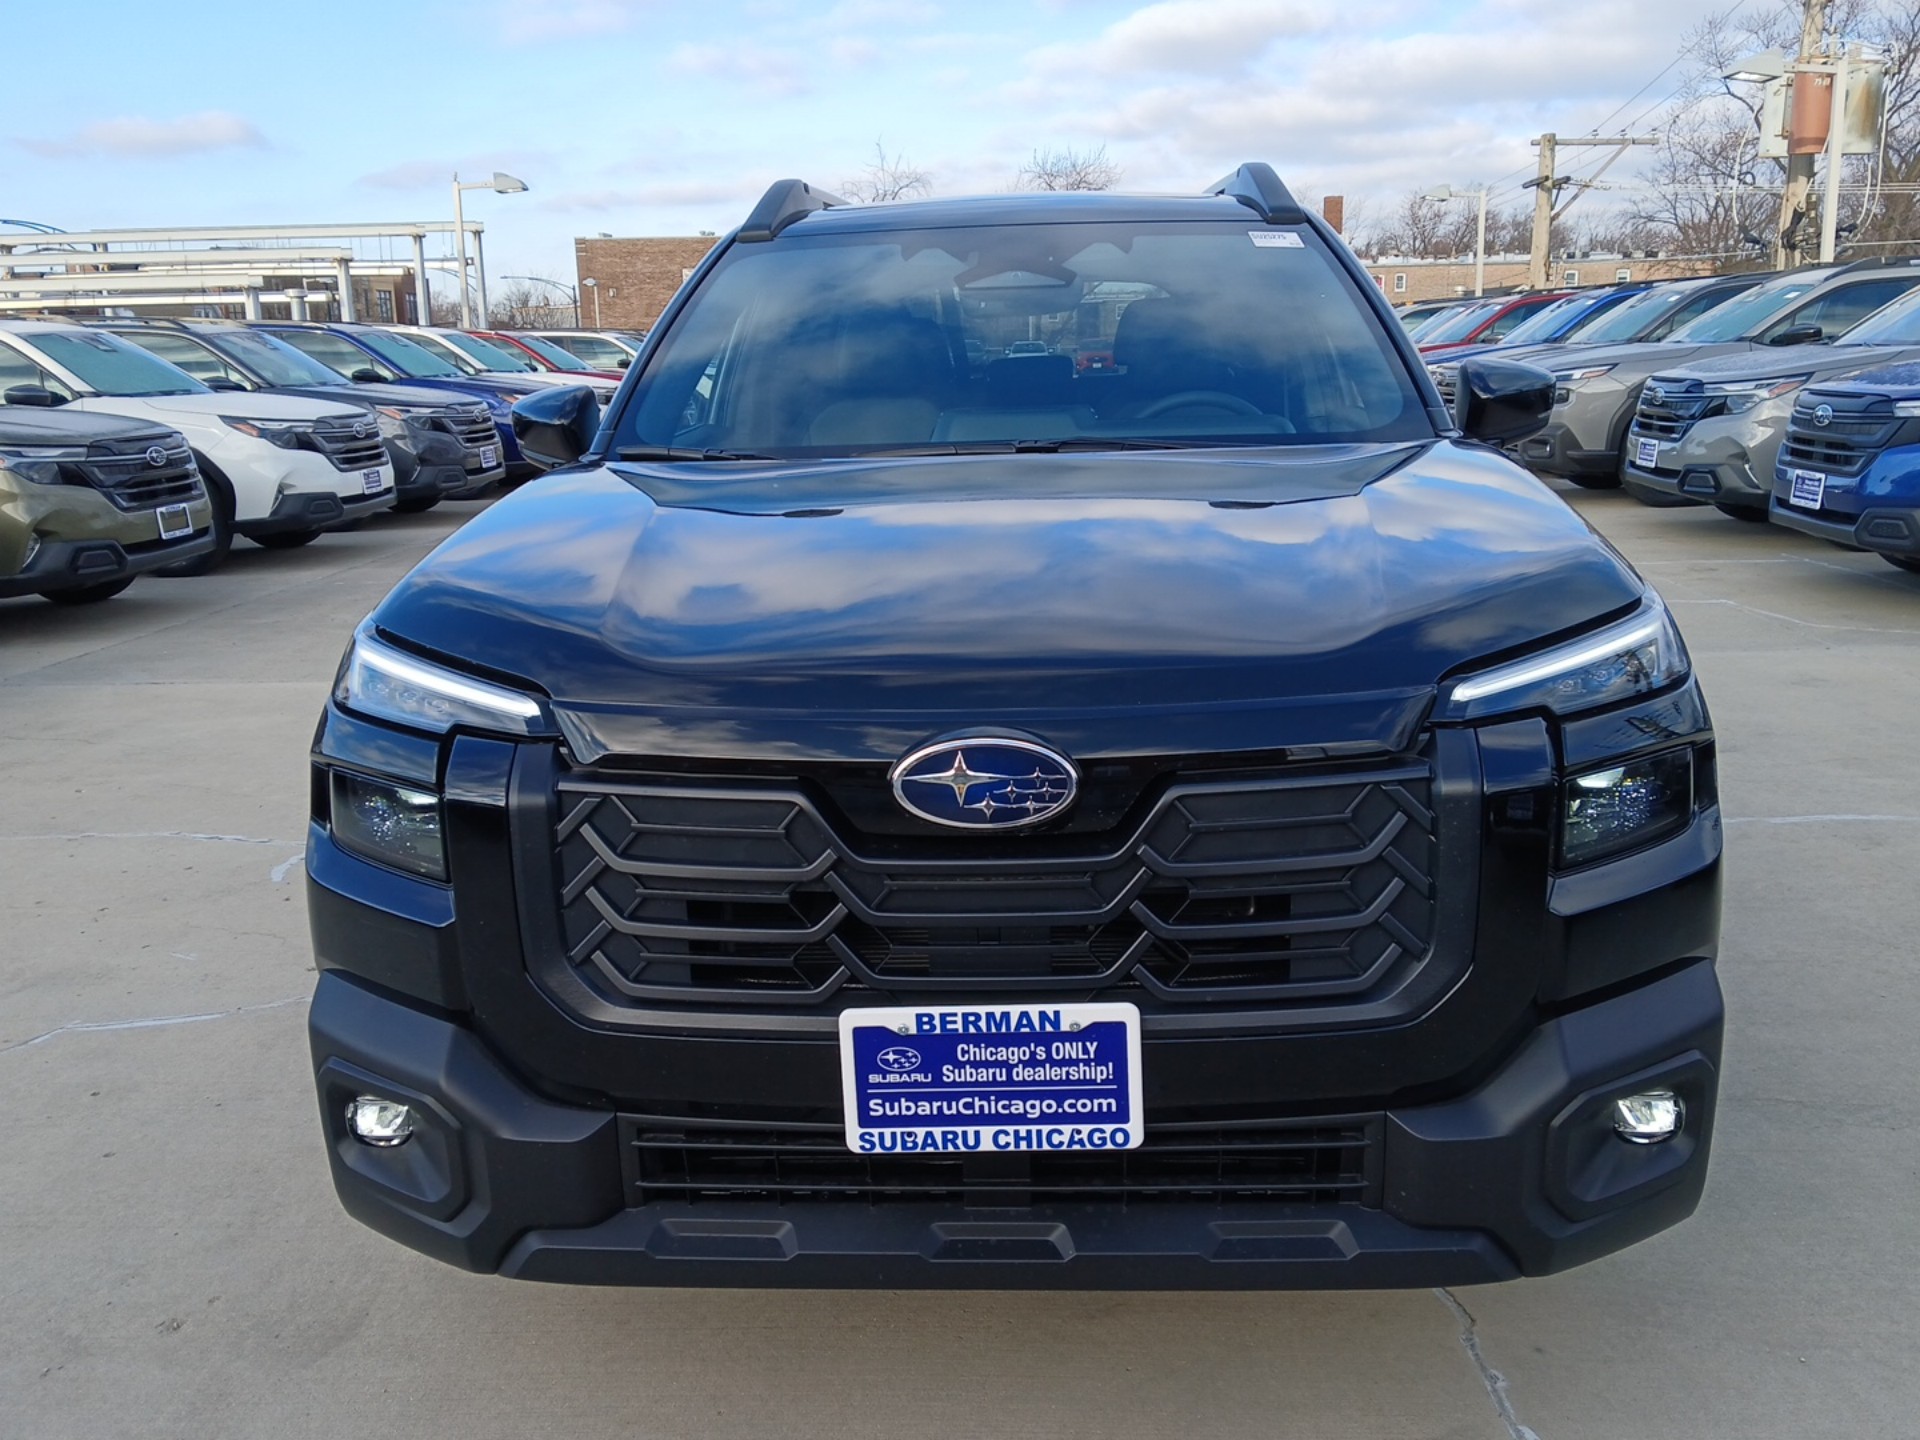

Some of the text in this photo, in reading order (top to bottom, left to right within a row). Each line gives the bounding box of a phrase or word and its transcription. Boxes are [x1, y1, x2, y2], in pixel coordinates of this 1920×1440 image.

[914, 1010, 1062, 1034] BERMAN
[956, 1042, 1098, 1064] Chicago's ONLY
[868, 1073, 932, 1083] SUBARU
[942, 1062, 1114, 1084] Subaru dealership!
[868, 1096, 1117, 1118] SubaruChicago.com
[858, 1127, 1131, 1152] SUBARU CHICAGO
